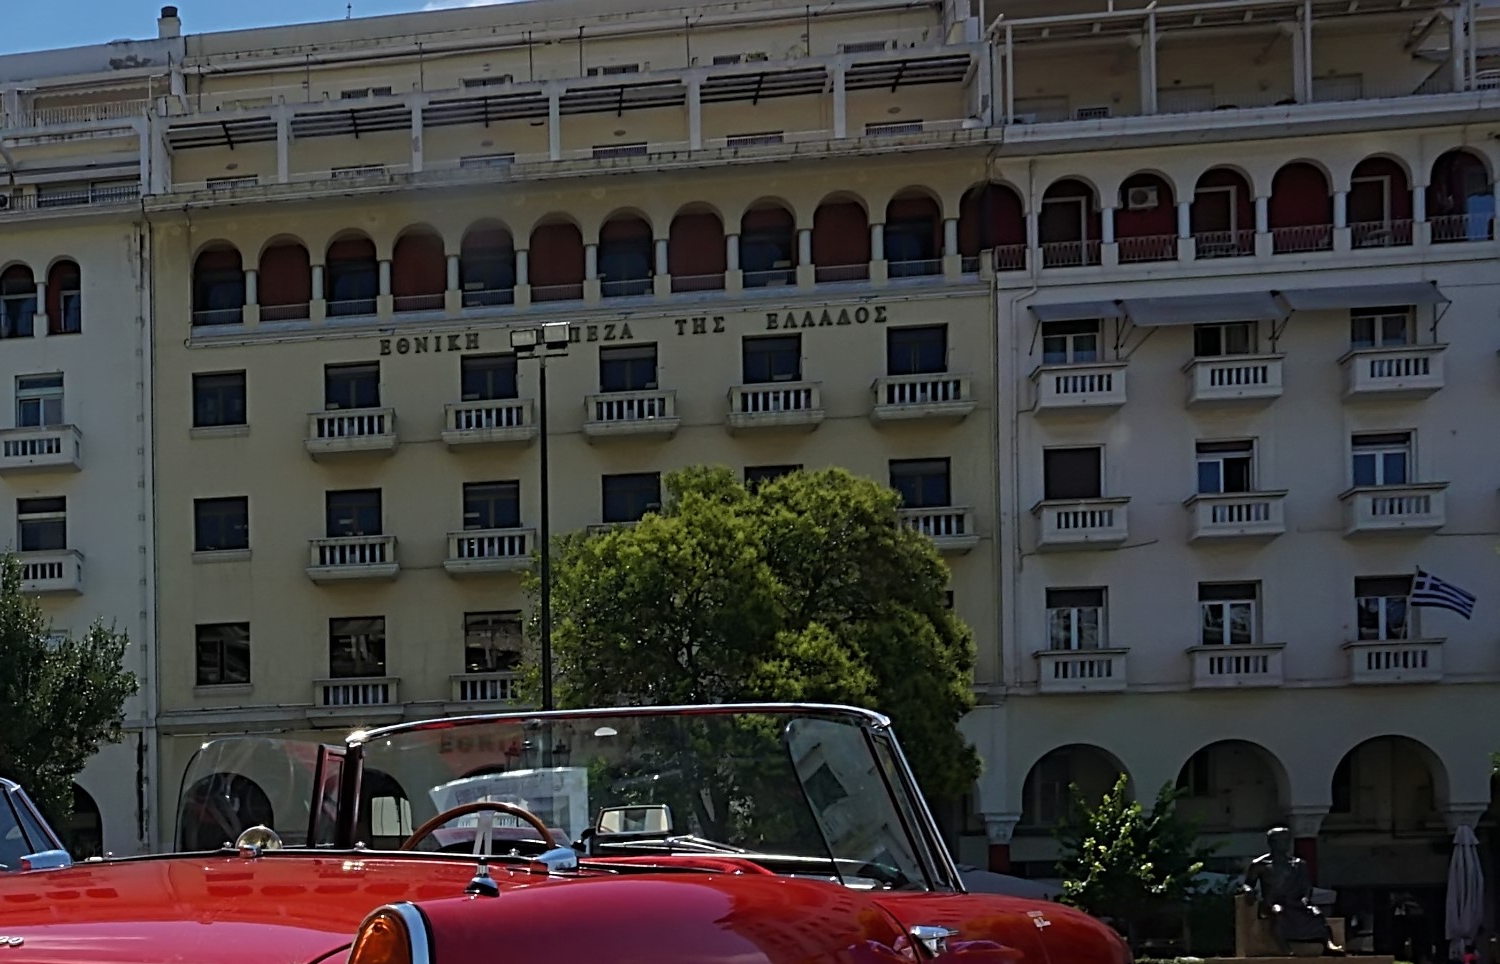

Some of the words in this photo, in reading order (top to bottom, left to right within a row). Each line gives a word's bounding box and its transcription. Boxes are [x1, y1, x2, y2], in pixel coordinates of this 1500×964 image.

[379, 332, 480, 356] ΕΘΝΙΚΗ
[675, 315, 726, 338] ΤΗΣ
[766, 306, 888, 331] ΕΛΛΑΔΟΣ
